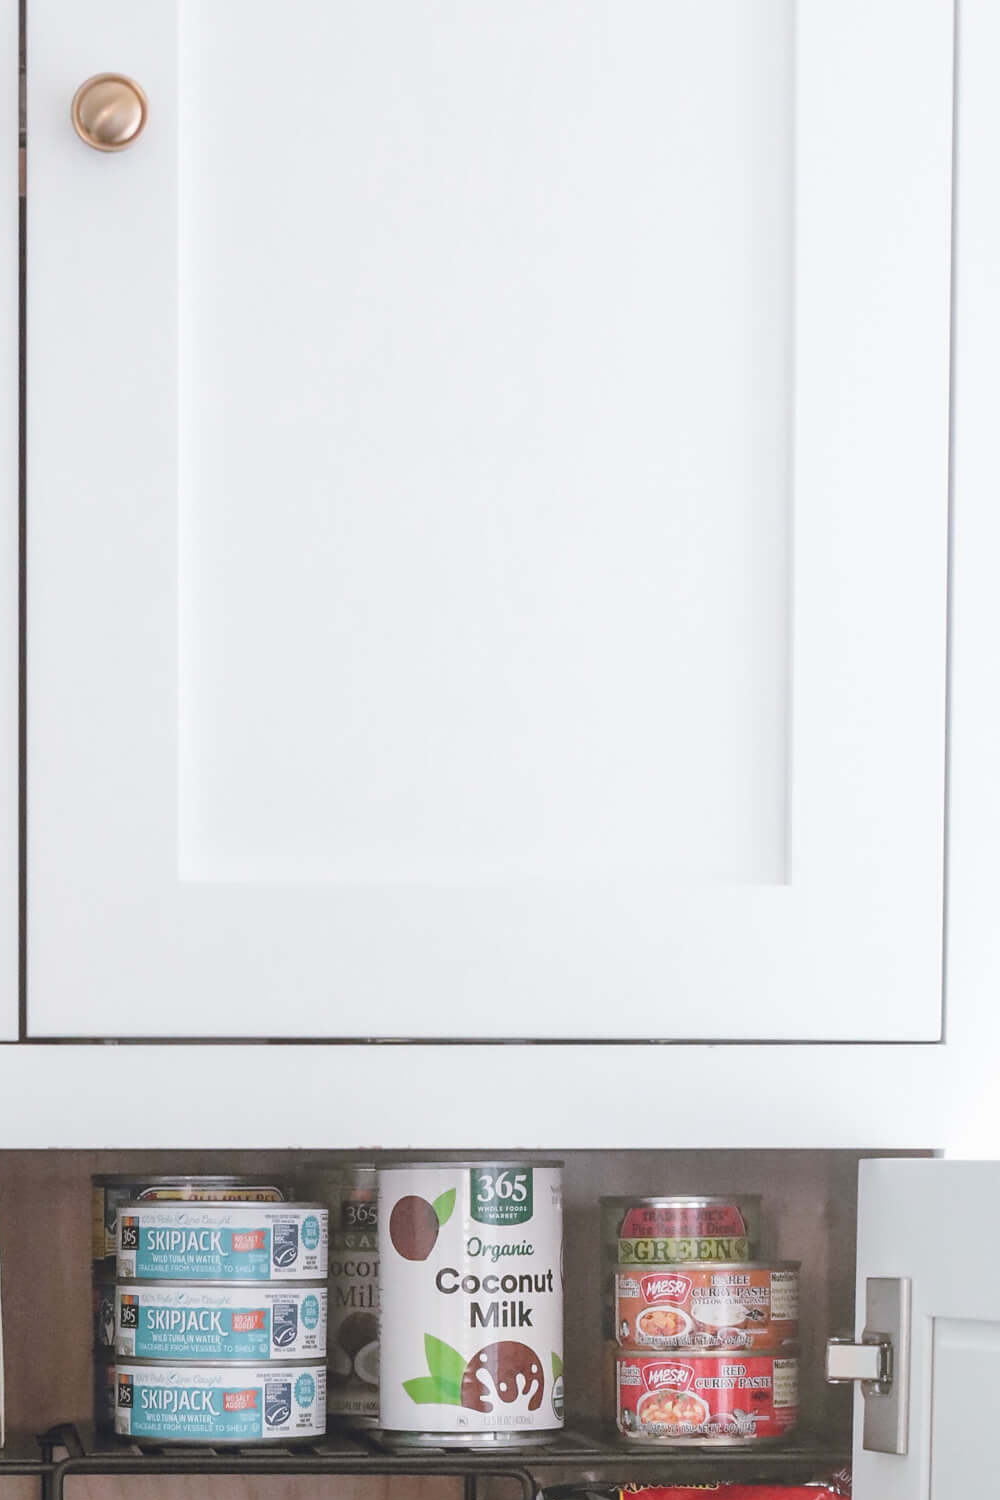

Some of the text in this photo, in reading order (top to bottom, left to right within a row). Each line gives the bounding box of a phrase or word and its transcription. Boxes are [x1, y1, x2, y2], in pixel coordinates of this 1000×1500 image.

[477, 1171, 528, 1202] 365
[346, 1202, 377, 1225] 365
[122, 1229, 136, 1245] 365
[147, 1230, 228, 1256] SKIPJACK
[466, 1237, 535, 1263] Organic
[634, 1239, 732, 1260] GREEN
[152, 1254, 221, 1264] WILD TUNA IN WATER
[170, 1264, 189, 1272] FROM
[224, 1264, 233, 1272] TO
[435, 1268, 554, 1294] Coconut
[336, 1284, 378, 1308] Mil
[691, 1287, 770, 1297] CURRY PASTE
[122, 1306, 136, 1323] 365
[147, 1309, 229, 1336] SKIPJACK
[469, 1301, 534, 1328] Milk
[152, 1333, 168, 1342] WILD
[195, 1334, 221, 1344] WATER
[224, 1344, 233, 1352] TO
[722, 1365, 746, 1377] RED
[694, 1377, 771, 1389] CURRY PASTE
[141, 1388, 221, 1416] SKIPJACK
[146, 1413, 161, 1422] WILD
[188, 1414, 214, 1424] WATER
[215, 1424, 225, 1432] TO
[226, 1424, 248, 1432] SHELF
